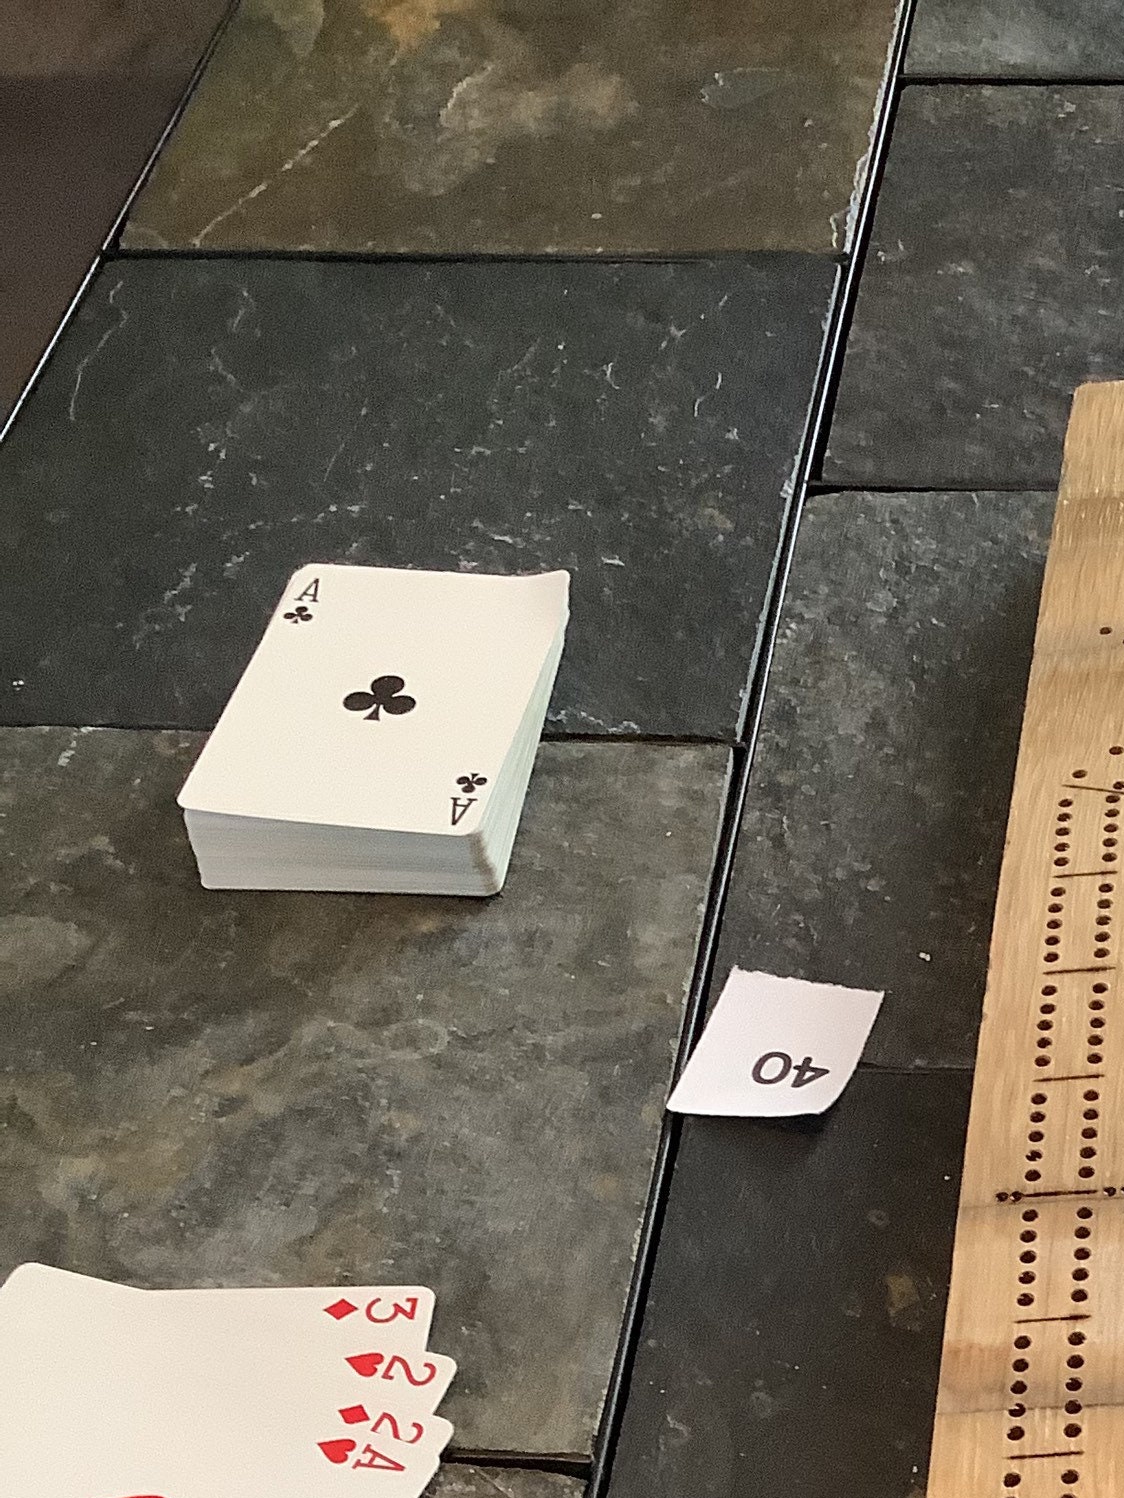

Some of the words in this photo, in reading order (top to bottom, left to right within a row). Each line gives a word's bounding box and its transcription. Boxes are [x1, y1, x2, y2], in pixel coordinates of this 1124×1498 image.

[294, 577, 320, 603] A
[449, 797, 478, 825] A
[752, 1051, 830, 1088] 40
[365, 1297, 419, 1324] 3
[381, 1354, 437, 1387] 2
[370, 1411, 424, 1445] 2
[352, 1443, 406, 1472] A
